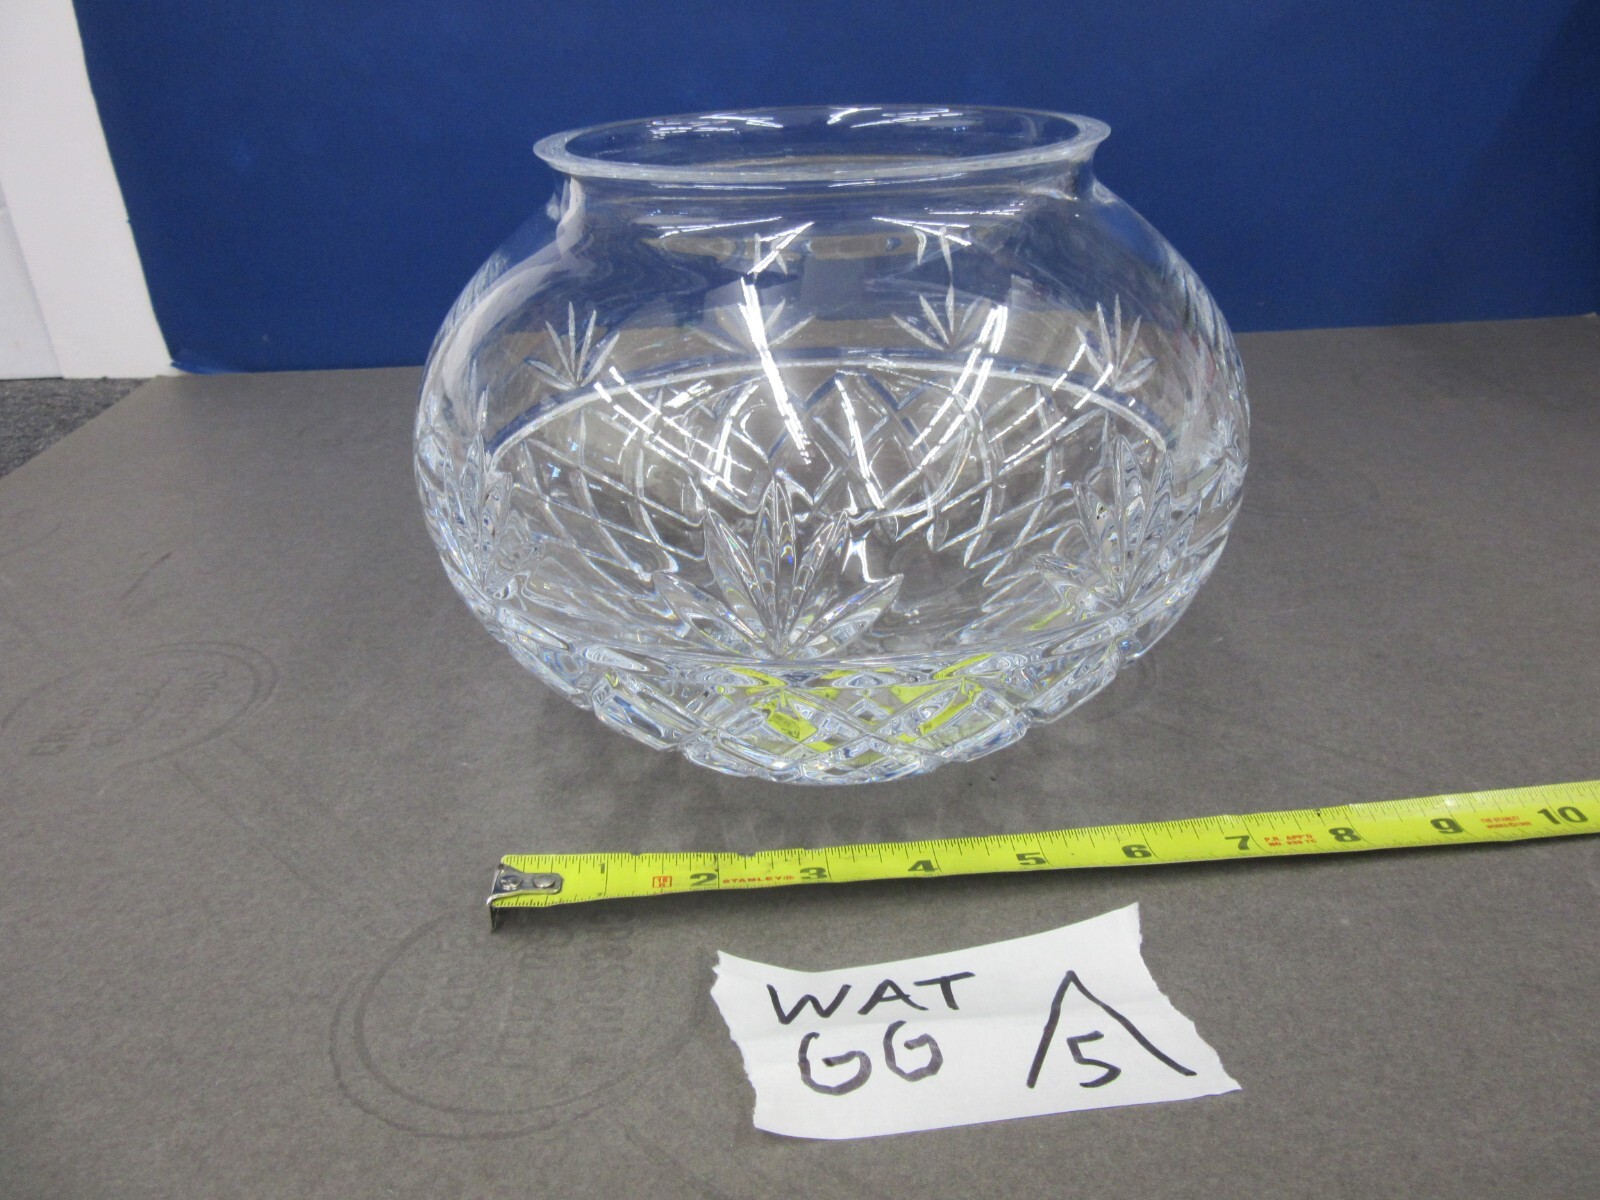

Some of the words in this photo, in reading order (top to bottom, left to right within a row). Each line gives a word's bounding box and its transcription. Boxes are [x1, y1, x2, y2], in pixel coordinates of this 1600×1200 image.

[1537, 806, 1589, 825] 10
[1430, 818, 1463, 834] 9
[1328, 827, 1361, 842] 8
[1224, 835, 1250, 850] 7
[1122, 844, 1152, 859] 6
[908, 859, 939, 873] 4
[1016, 852, 1046, 867] 5
[690, 872, 718, 887] 2
[800, 867, 828, 880] 3
[766, 971, 976, 1025] WAT
[797, 1020, 944, 1096] GG
[1066, 1030, 1122, 1088] 5
